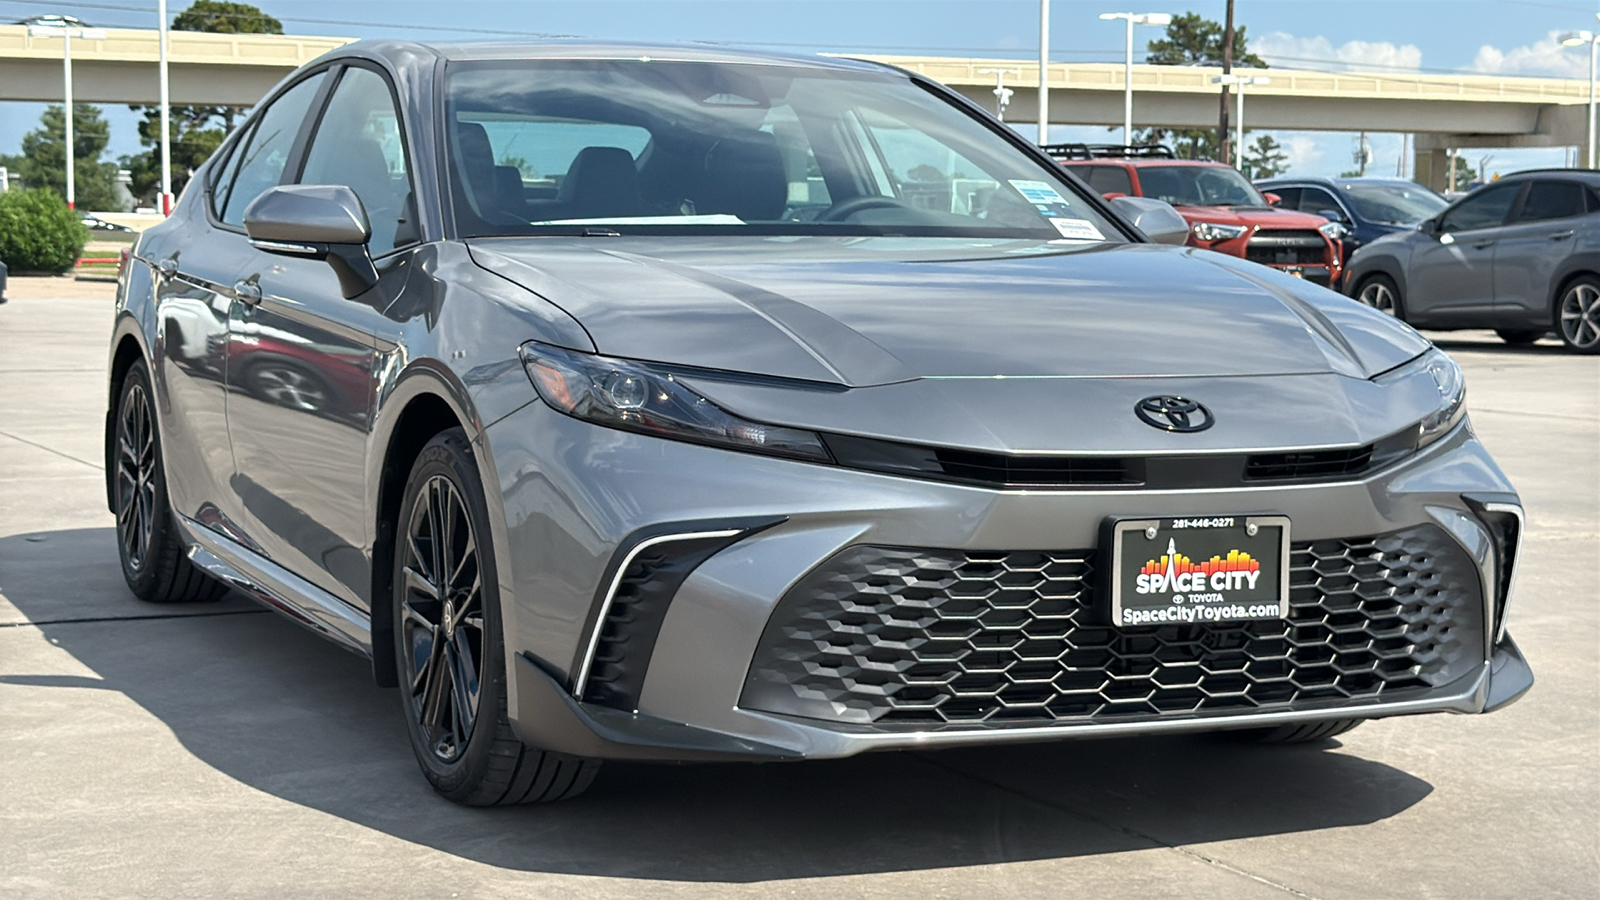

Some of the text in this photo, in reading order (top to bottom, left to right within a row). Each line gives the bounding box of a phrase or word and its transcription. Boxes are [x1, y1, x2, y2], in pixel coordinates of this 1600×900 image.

[1172, 518, 1234, 528] 281-446-0271
[1136, 570, 1260, 594] SPACE CITY
[1188, 593, 1224, 603] TOYOTA
[1123, 604, 1280, 625] SpaceCityToyota.com
